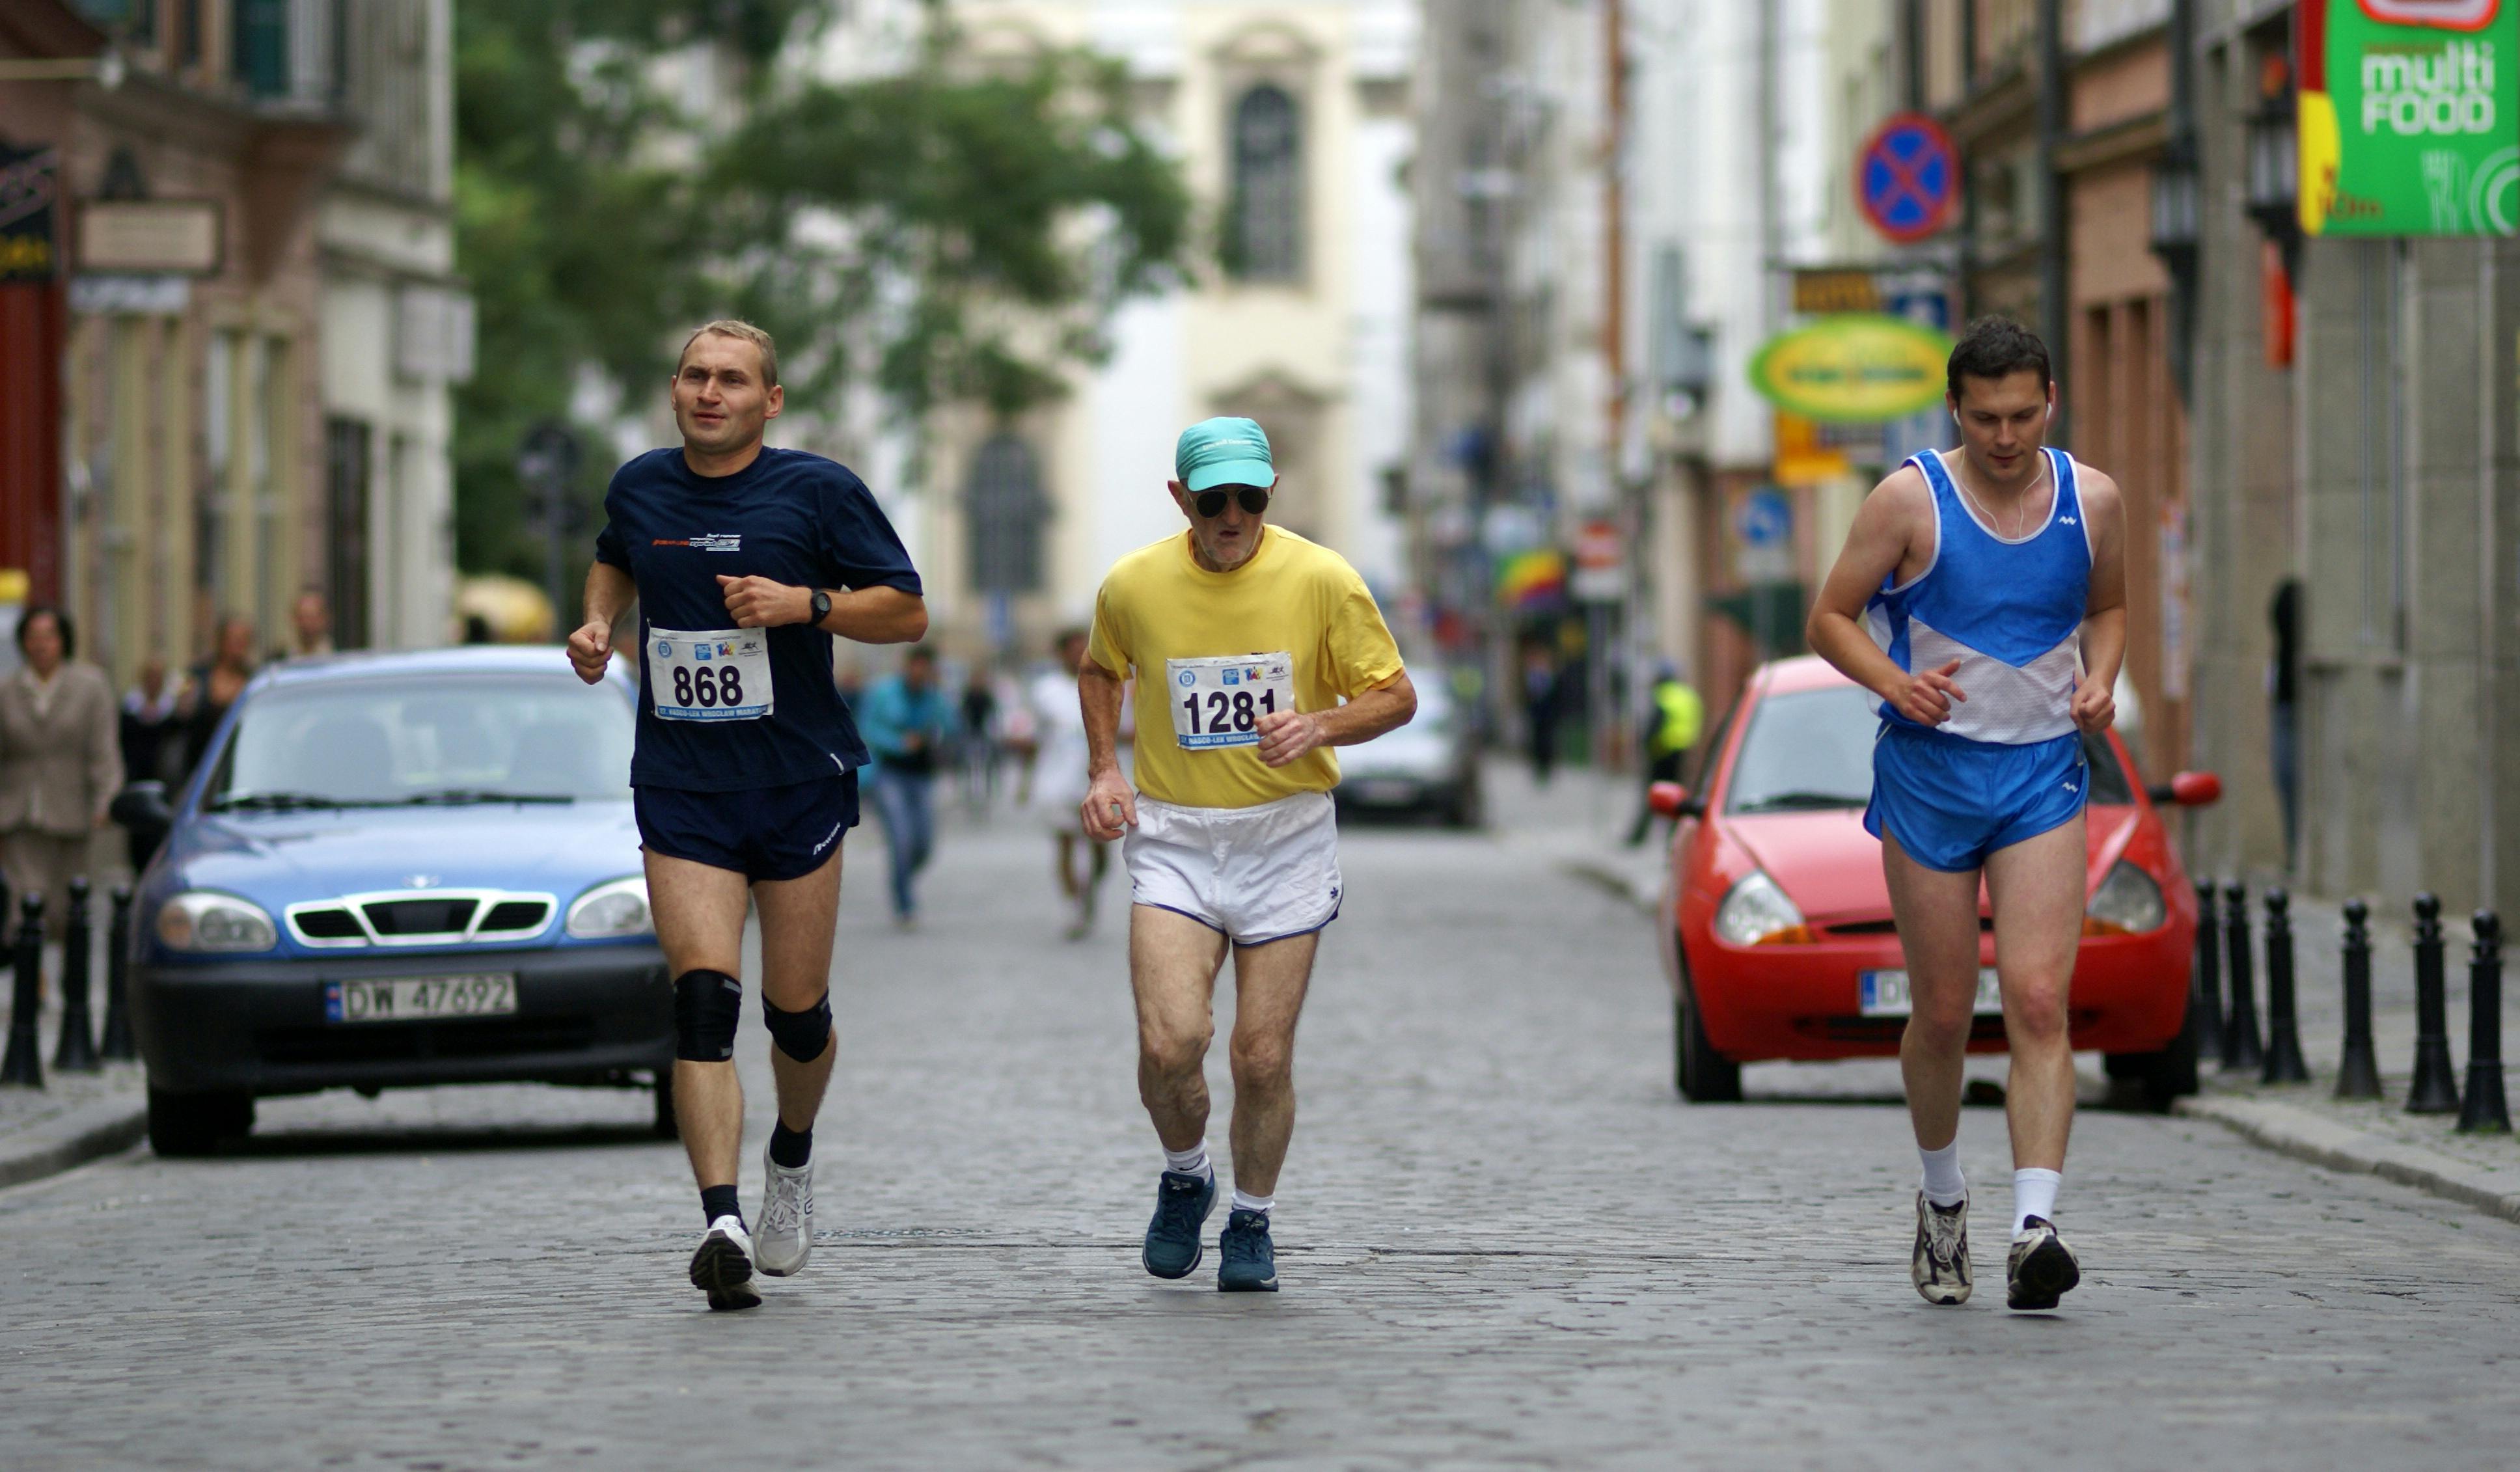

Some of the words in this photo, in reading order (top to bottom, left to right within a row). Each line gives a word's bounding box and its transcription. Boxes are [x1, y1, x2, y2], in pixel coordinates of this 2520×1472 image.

[2362, 40, 2495, 89] multi
[2362, 93, 2495, 135] FOOD
[673, 665, 743, 707] 868
[1183, 688, 1275, 735] 1281
[348, 981, 394, 1016] DW
[412, 976, 510, 1011] 47692
